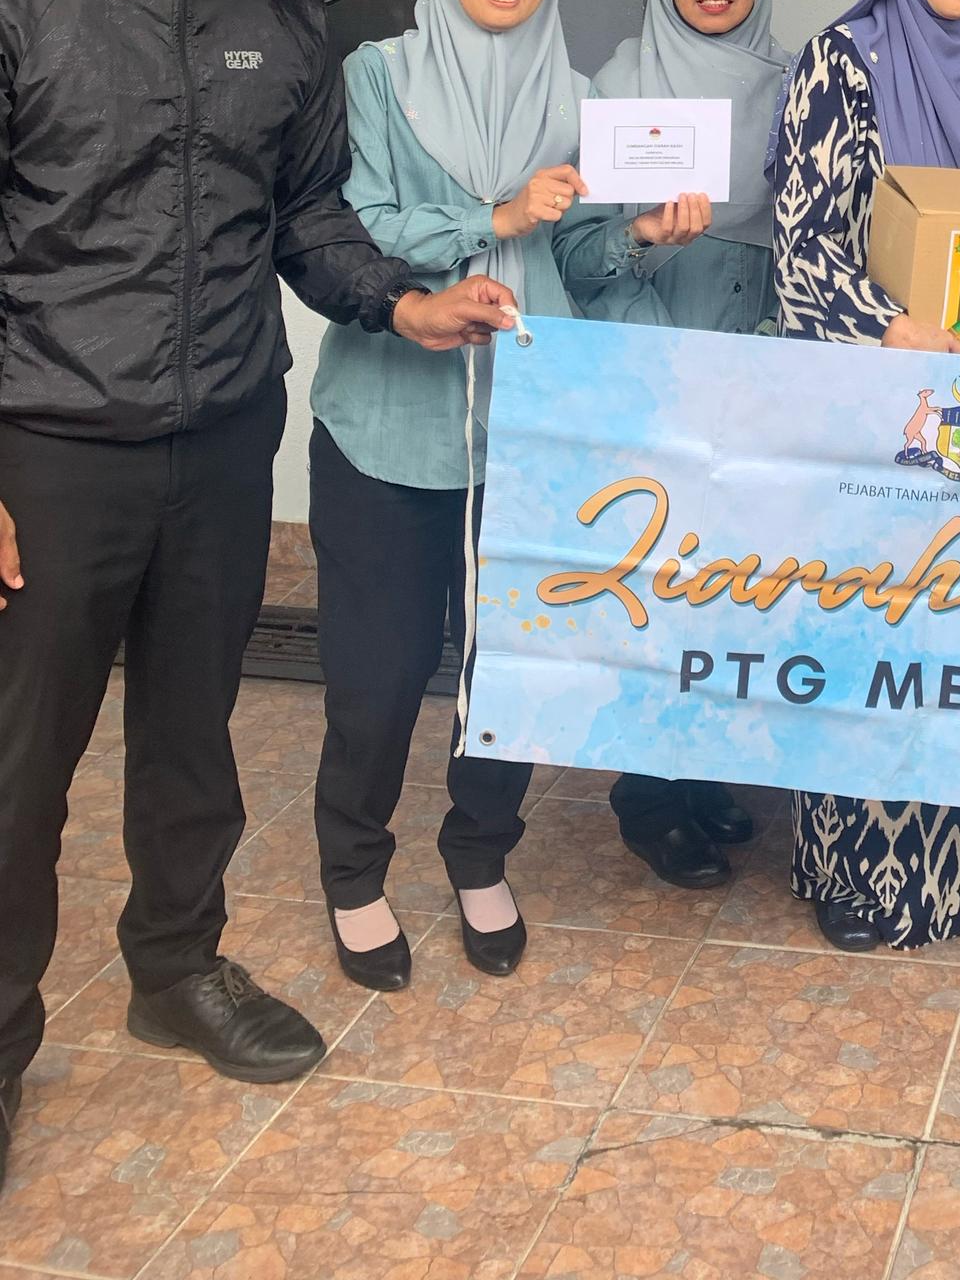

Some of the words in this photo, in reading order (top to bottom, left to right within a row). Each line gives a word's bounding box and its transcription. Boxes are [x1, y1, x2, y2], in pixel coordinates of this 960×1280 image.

[224, 51, 263, 62] HYPER
[226, 60, 258, 69] GEAR
[839, 482, 893, 498] PEJABAT
[895, 488, 939, 502] TANAH
[679, 650, 826, 705] PTG
